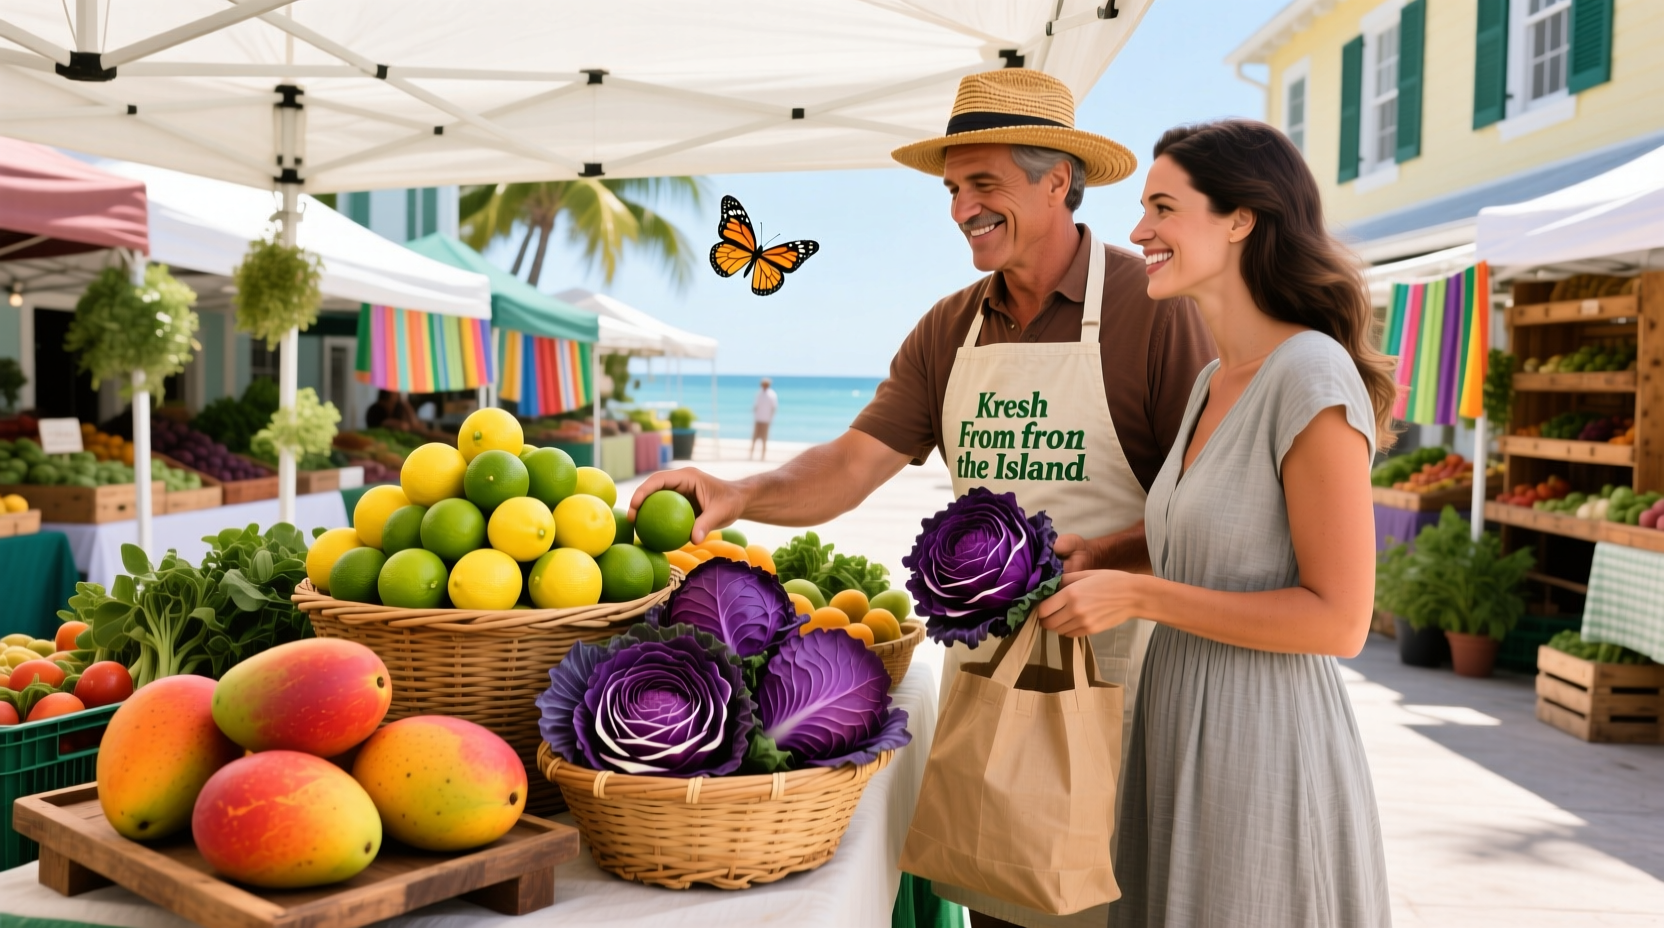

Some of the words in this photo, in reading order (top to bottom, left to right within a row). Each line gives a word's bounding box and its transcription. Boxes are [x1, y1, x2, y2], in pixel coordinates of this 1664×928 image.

[975, 391, 1048, 419] Kresh
[958, 421, 1016, 449] From
[1021, 421, 1086, 450] fron
[957, 451, 989, 479] the
